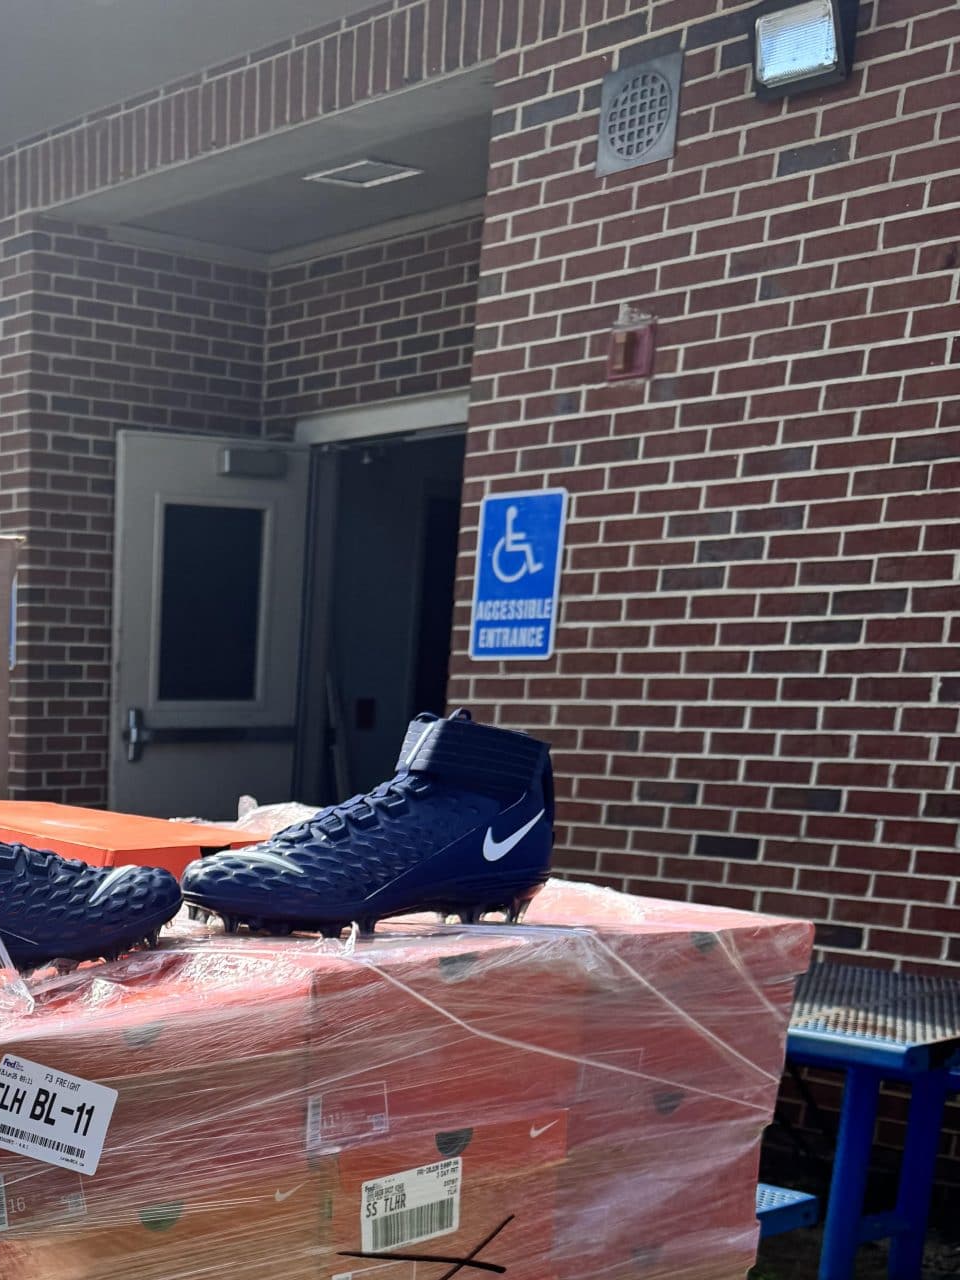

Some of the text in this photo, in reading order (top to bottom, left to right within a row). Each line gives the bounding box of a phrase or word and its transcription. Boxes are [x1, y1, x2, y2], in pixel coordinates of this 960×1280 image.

[476, 597, 552, 621] ACCESSIBLE
[478, 627, 544, 648] ENTRANCE
[44, 1073, 81, 1092] F3 FREIGHT
[29, 1088, 96, 1137] BL-11
[8, 1196, 26, 1214] 16
[365, 1201, 378, 1219] SS
[384, 1193, 406, 1213] TLHR
